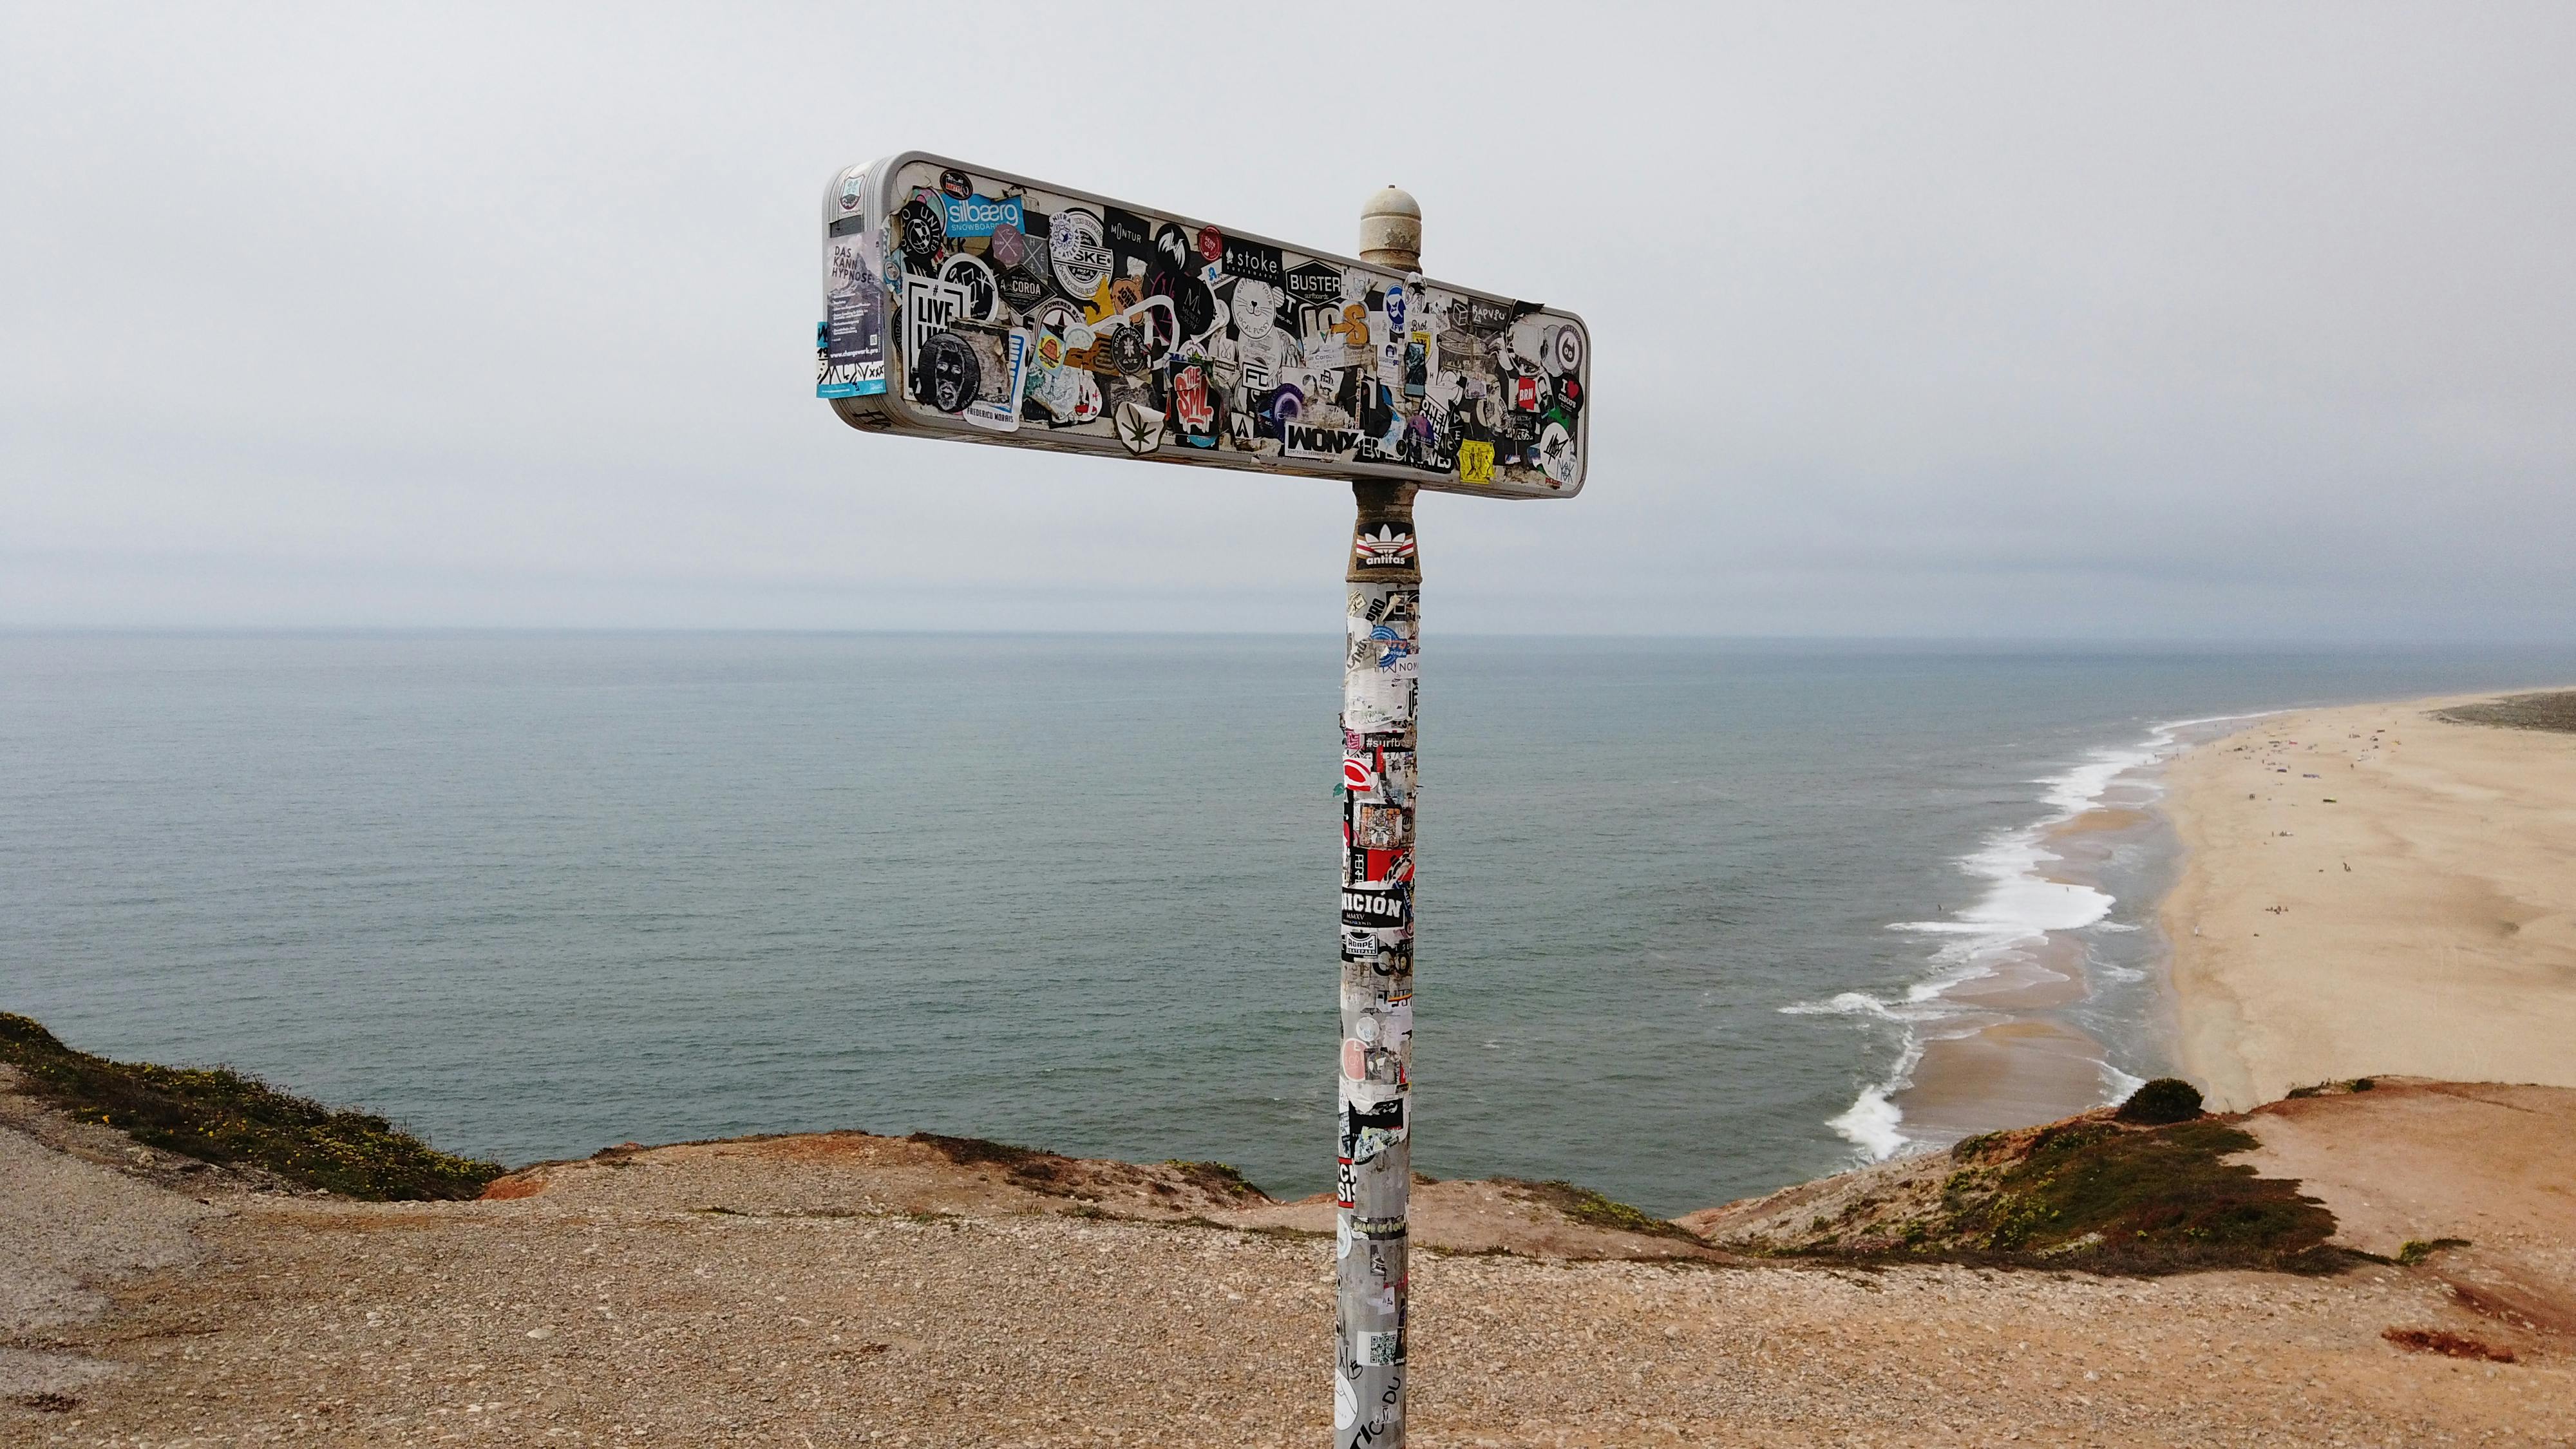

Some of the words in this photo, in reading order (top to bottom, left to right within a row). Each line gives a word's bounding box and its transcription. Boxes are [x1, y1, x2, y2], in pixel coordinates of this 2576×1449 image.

[1052, 214, 1071, 223] NITRA
[920, 207, 940, 251] UNITED
[835, 245, 851, 258] DAS
[833, 256, 857, 270] KANN
[1237, 250, 1277, 273] stoke
[1012, 280, 1041, 295] COROA
[1290, 274, 1340, 292] BUSTER
[918, 296, 953, 325] LIVE
[1045, 301, 1072, 310] POWERED
[1391, 323, 1403, 332] IFW
[1410, 319, 1428, 332] Brot
[1184, 367, 1200, 384] THE
[1519, 388, 1533, 401] BRN
[1366, 553, 1405, 565] antifas
[1349, 938, 1373, 948] AGAPE
